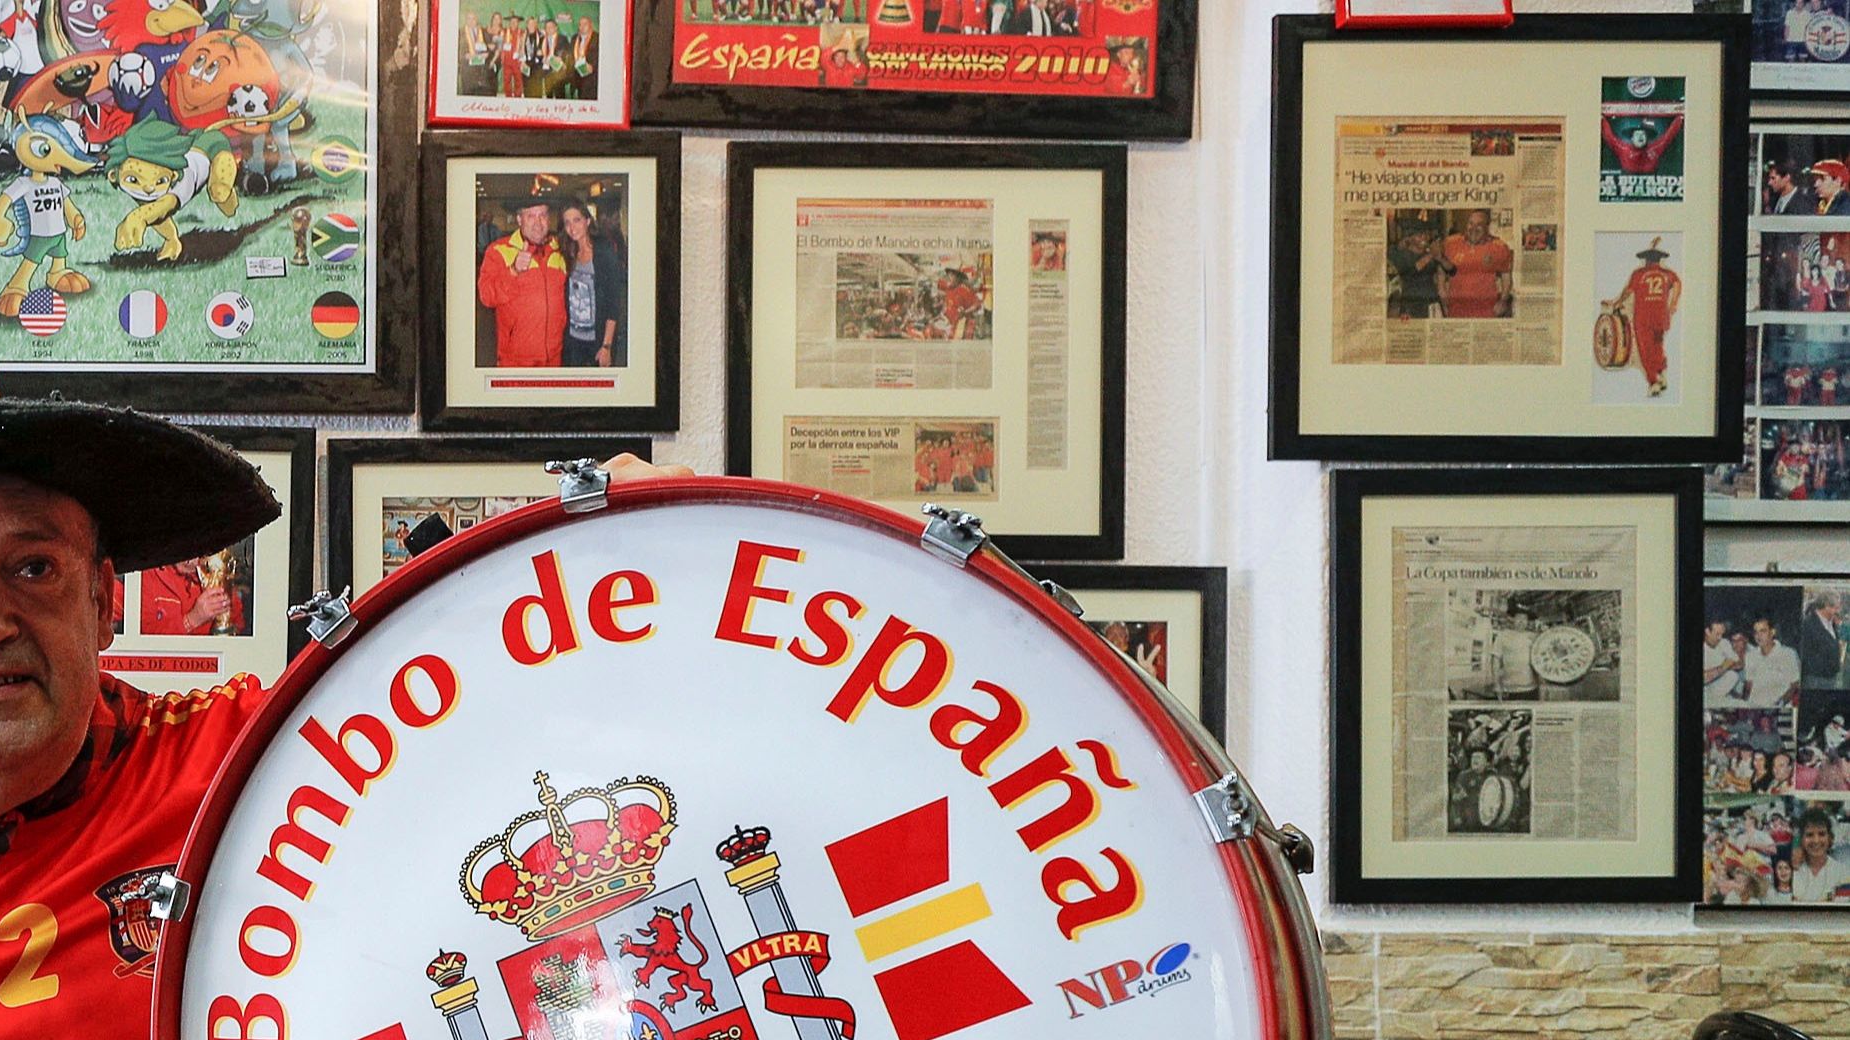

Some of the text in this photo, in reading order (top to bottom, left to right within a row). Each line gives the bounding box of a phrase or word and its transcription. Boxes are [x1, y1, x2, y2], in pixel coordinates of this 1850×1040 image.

[679, 33, 821, 81] España
[1011, 45, 1111, 85] 2010
[916, 61, 1007, 82] MUNDO
[1376, 170, 1425, 187] viajado
[1428, 174, 1456, 184] con
[1460, 170, 1473, 184] lo
[1476, 173, 1504, 187] que
[1344, 190, 1368, 201] me
[1372, 190, 1409, 204] paga
[1412, 188, 1460, 205] Burger
[32, 198, 62, 213] 2014
[797, 235, 807, 248] El
[811, 235, 854, 248] Bombo
[857, 236, 872, 248] de
[876, 235, 919, 248] Manolo
[923, 236, 953, 248] echa
[1645, 276, 1663, 294] 12
[791, 426, 900, 440] Decepción entre los VIP
[791, 439, 899, 451] por la derrota española
[1405, 567, 1598, 582] La Copa también es de Manolo
[128, 659, 145, 670] ES
[149, 659, 166, 670] DE
[173, 660, 217, 671] TODOS
[501, 549, 660, 667] de
[714, 540, 1146, 942] España
[732, 935, 823, 970] VLTRA
